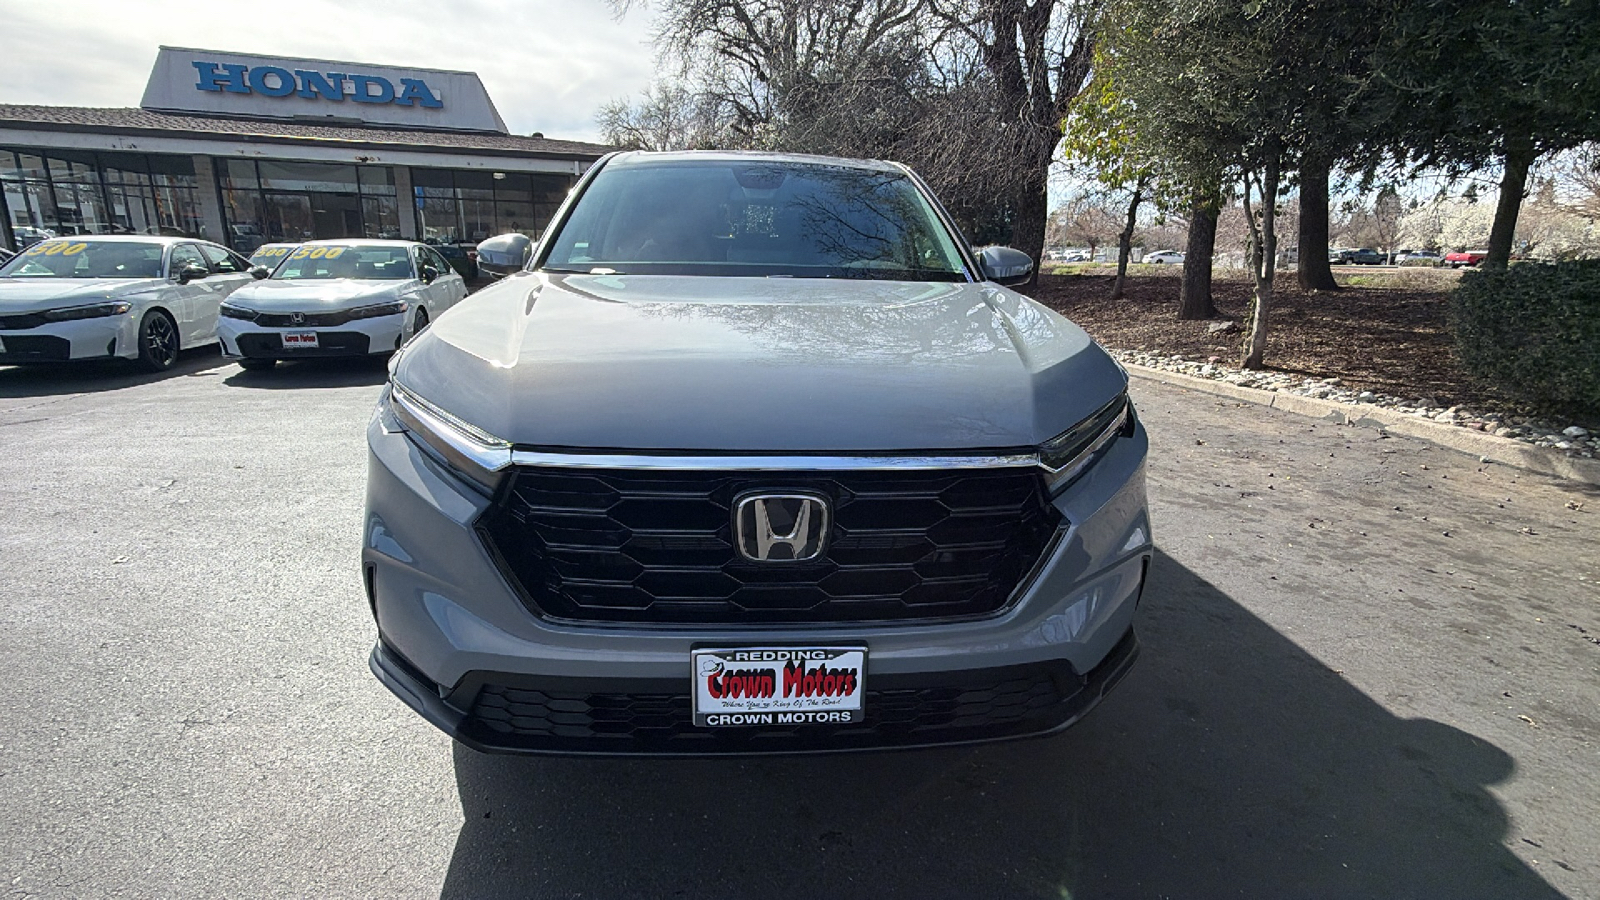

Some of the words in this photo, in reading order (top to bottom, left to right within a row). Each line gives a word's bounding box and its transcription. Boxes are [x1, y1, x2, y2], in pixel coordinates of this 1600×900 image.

[192, 61, 443, 108] HONDA
[735, 651, 825, 661] REDDING
[707, 664, 776, 699] Crown
[783, 660, 857, 699] Motors
[721, 700, 744, 708] Where
[773, 700, 790, 708] King
[793, 699, 804, 708] Of
[806, 698, 819, 706] The
[821, 698, 842, 706] Road
[706, 714, 772, 725] CROWN
[778, 711, 851, 723] MOTORS
